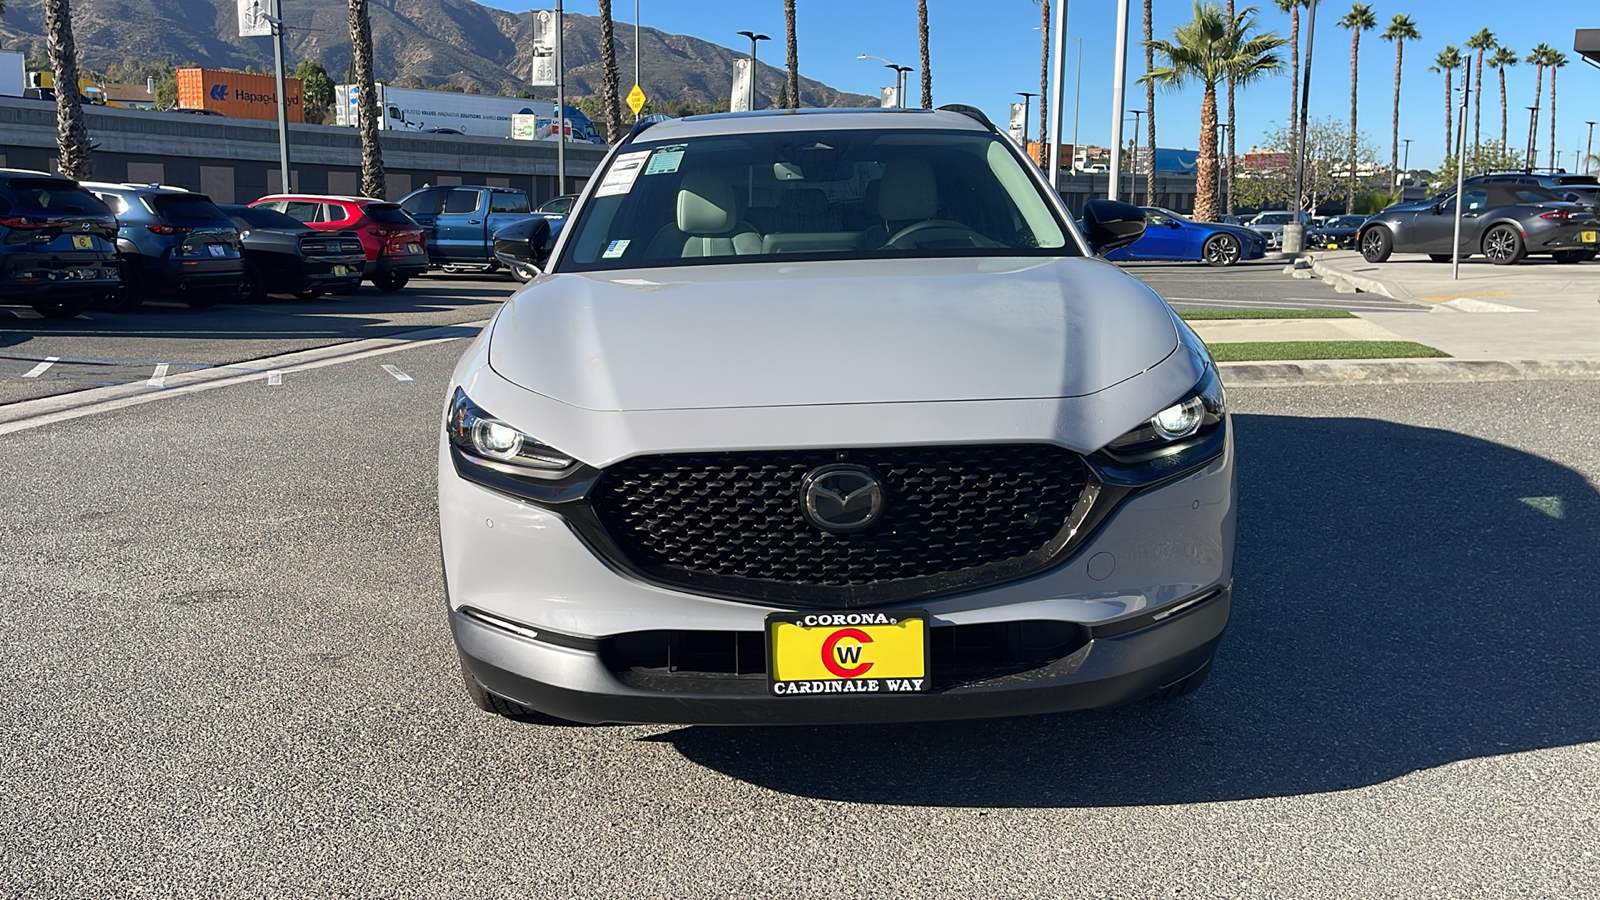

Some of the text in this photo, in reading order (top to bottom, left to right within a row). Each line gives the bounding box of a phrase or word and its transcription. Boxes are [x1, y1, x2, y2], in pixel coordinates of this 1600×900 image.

[235, 89, 299, 106] Hapag-Lyd
[804, 613, 889, 626] CORONA
[836, 644, 863, 664] W
[773, 679, 925, 695] CARDINALE WAY
